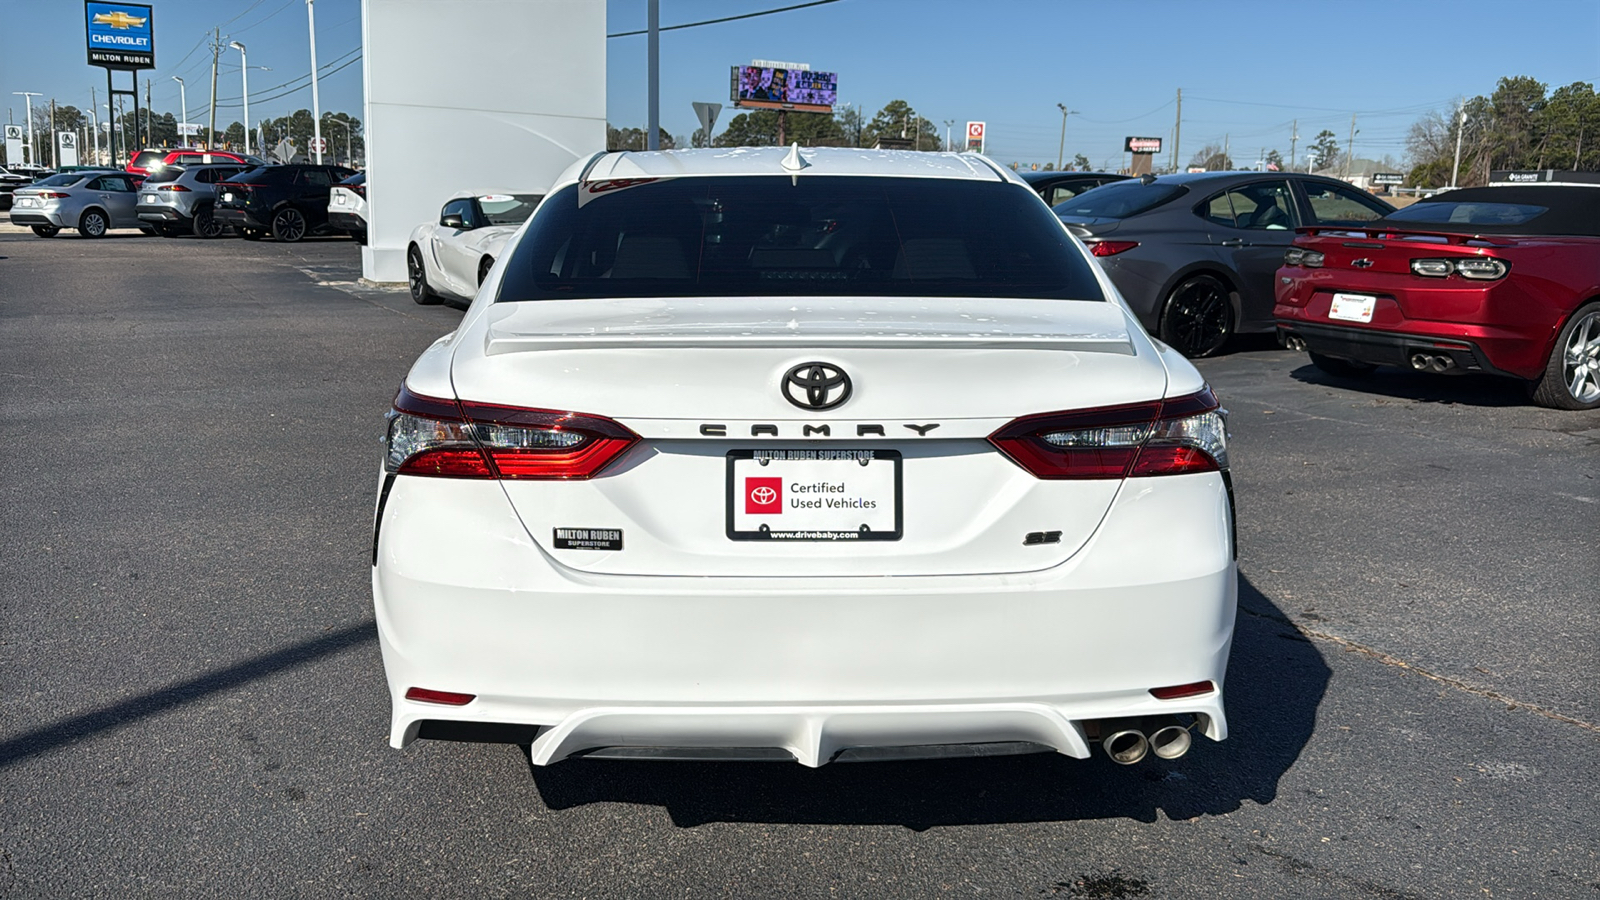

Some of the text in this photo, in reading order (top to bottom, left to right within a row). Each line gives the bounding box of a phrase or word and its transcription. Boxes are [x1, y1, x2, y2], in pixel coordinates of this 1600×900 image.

[92, 34, 148, 46] CHEVROLET
[92, 53, 150, 64] MILTON RUBEN
[699, 423, 941, 437] CAMRY
[753, 450, 875, 461] MILTON RUBEN SUPERSTORE
[790, 482, 845, 494] Certified
[790, 497, 877, 509] Used Vehicles
[556, 529, 620, 541] MILTON RUBEN
[770, 530, 859, 541] www.drivebaby.com
